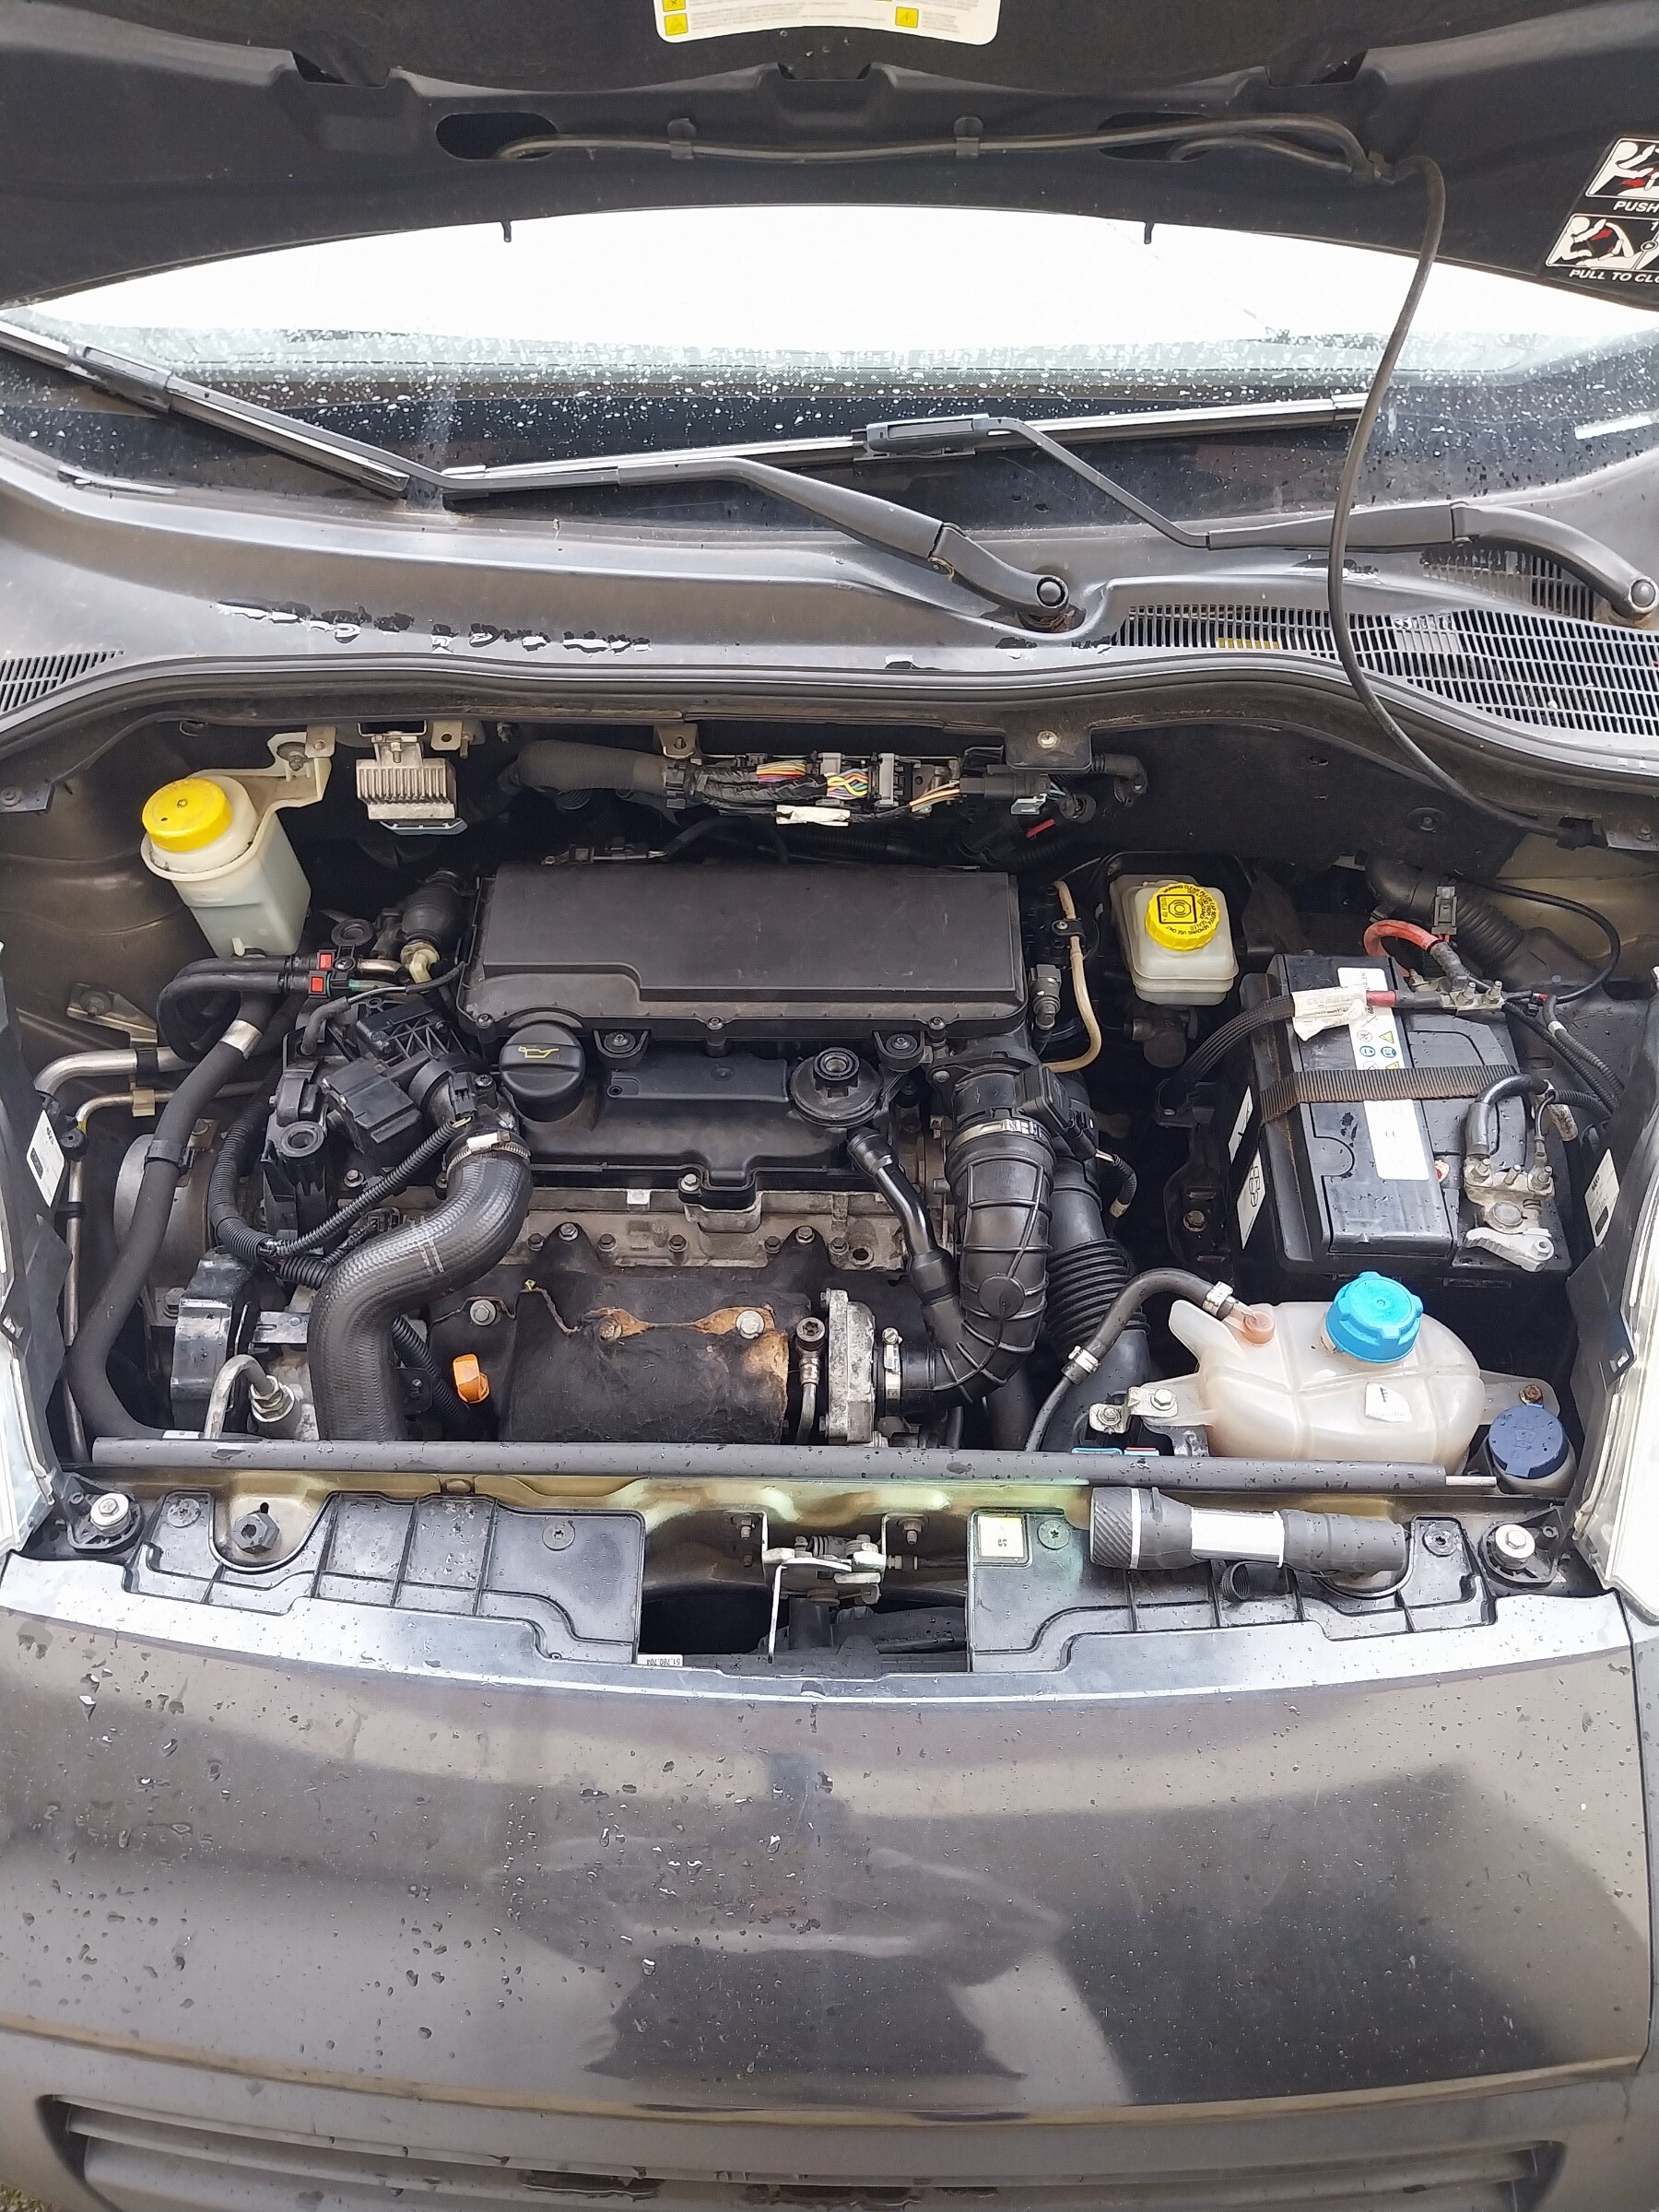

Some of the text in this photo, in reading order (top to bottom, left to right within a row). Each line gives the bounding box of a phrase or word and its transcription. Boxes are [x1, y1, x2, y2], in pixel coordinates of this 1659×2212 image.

[1613, 200, 1659, 213] PUSH
[1569, 269, 1606, 280] PULL
[1612, 271, 1632, 281] TO
